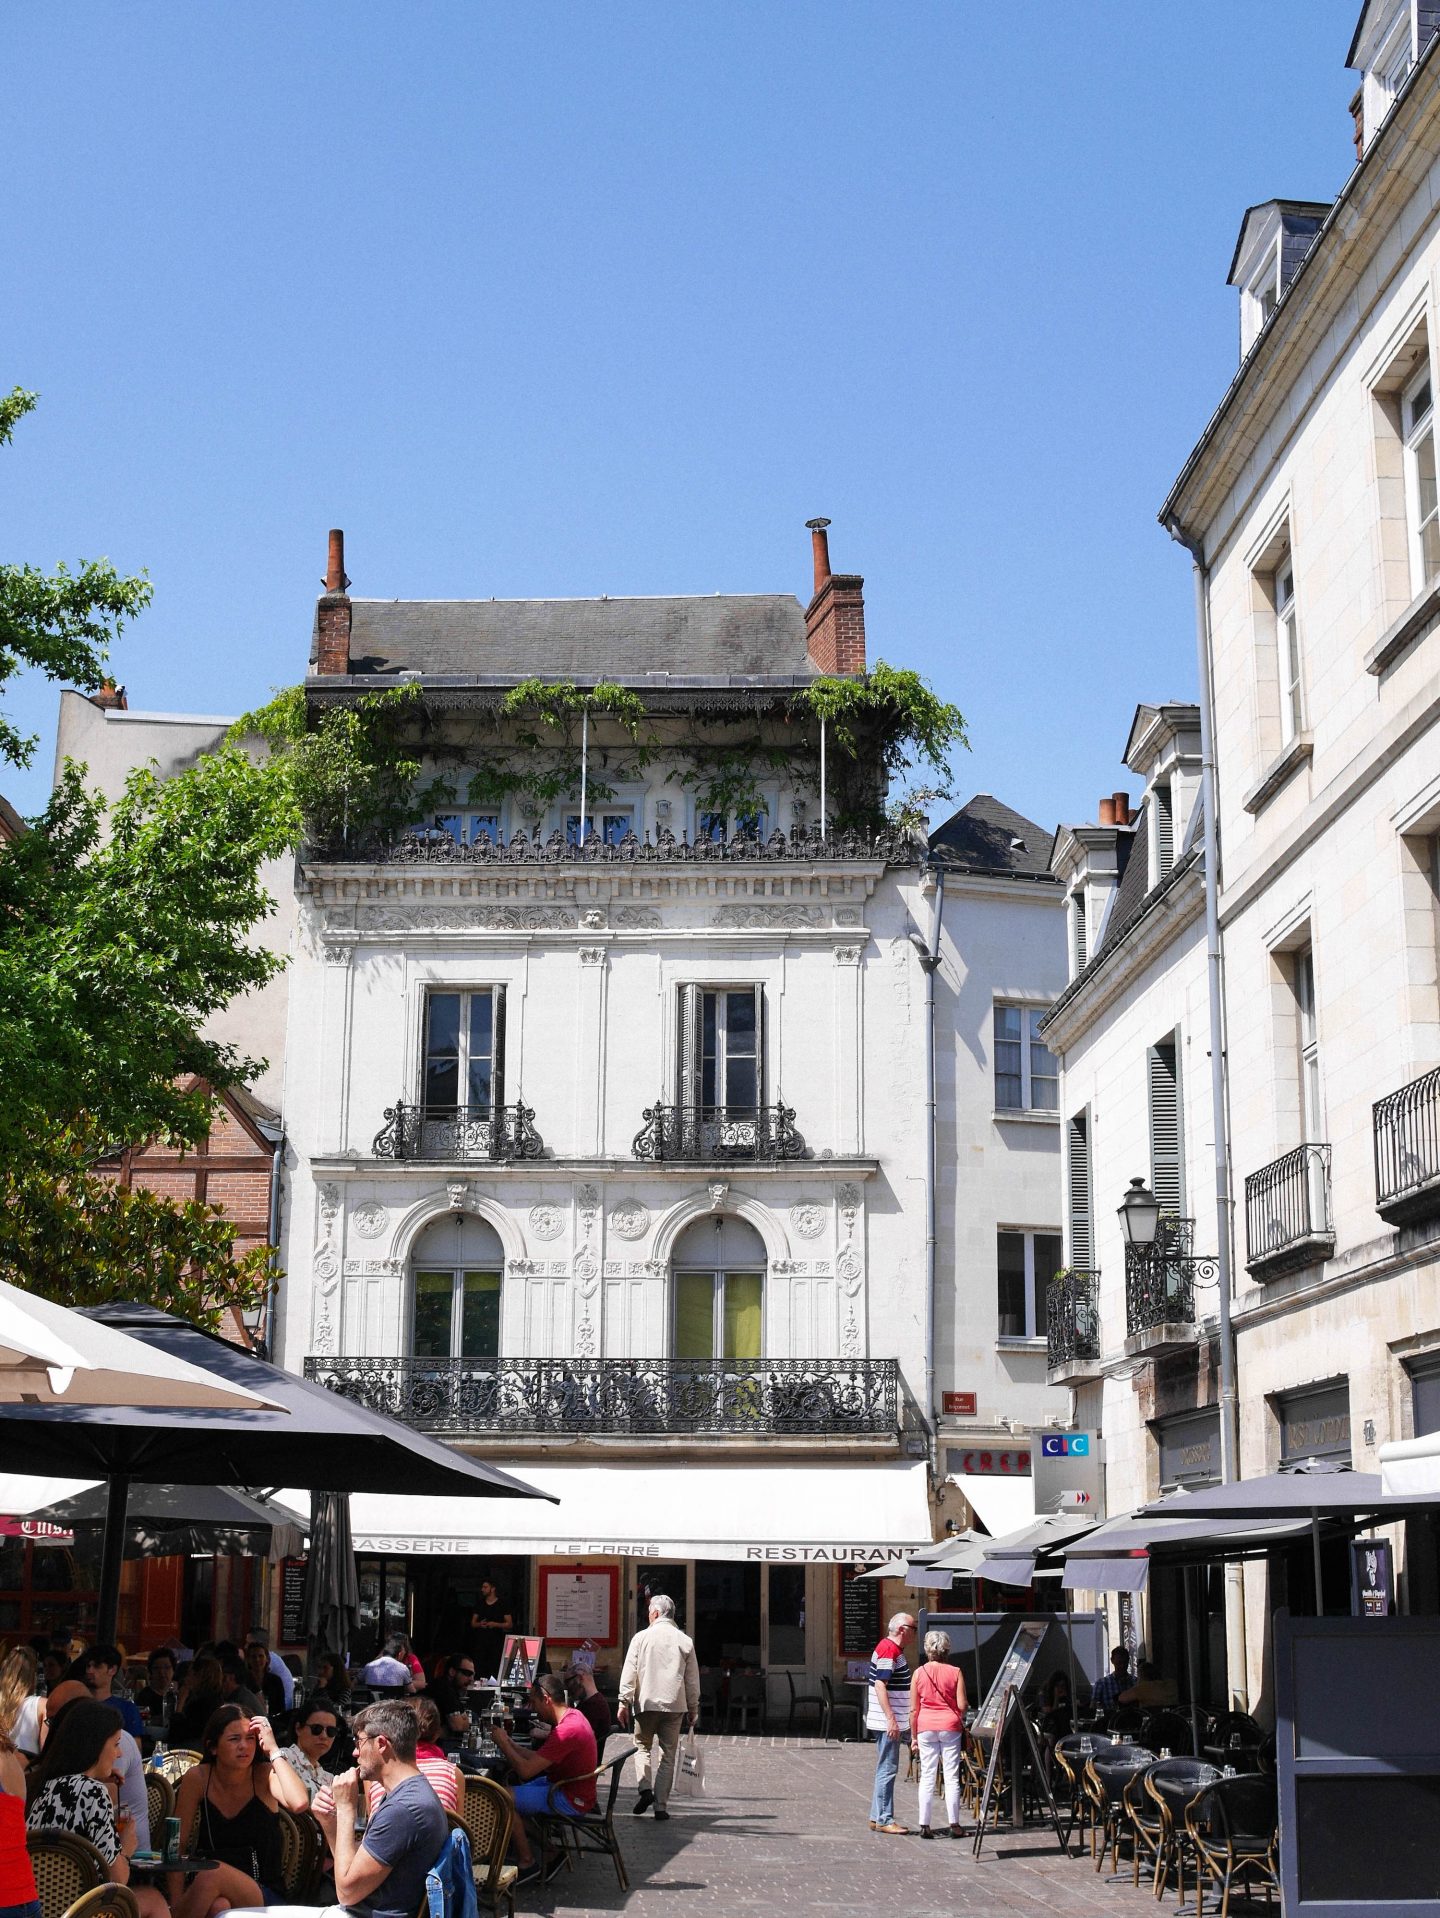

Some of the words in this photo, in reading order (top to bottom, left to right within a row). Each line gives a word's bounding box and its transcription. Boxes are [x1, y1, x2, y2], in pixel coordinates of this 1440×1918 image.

[1046, 1438, 1085, 1453] CIC
[553, 1544, 581, 1555] LE
[588, 1543, 660, 1557] CARRÉ
[746, 1547, 920, 1560] RESTAURANT
